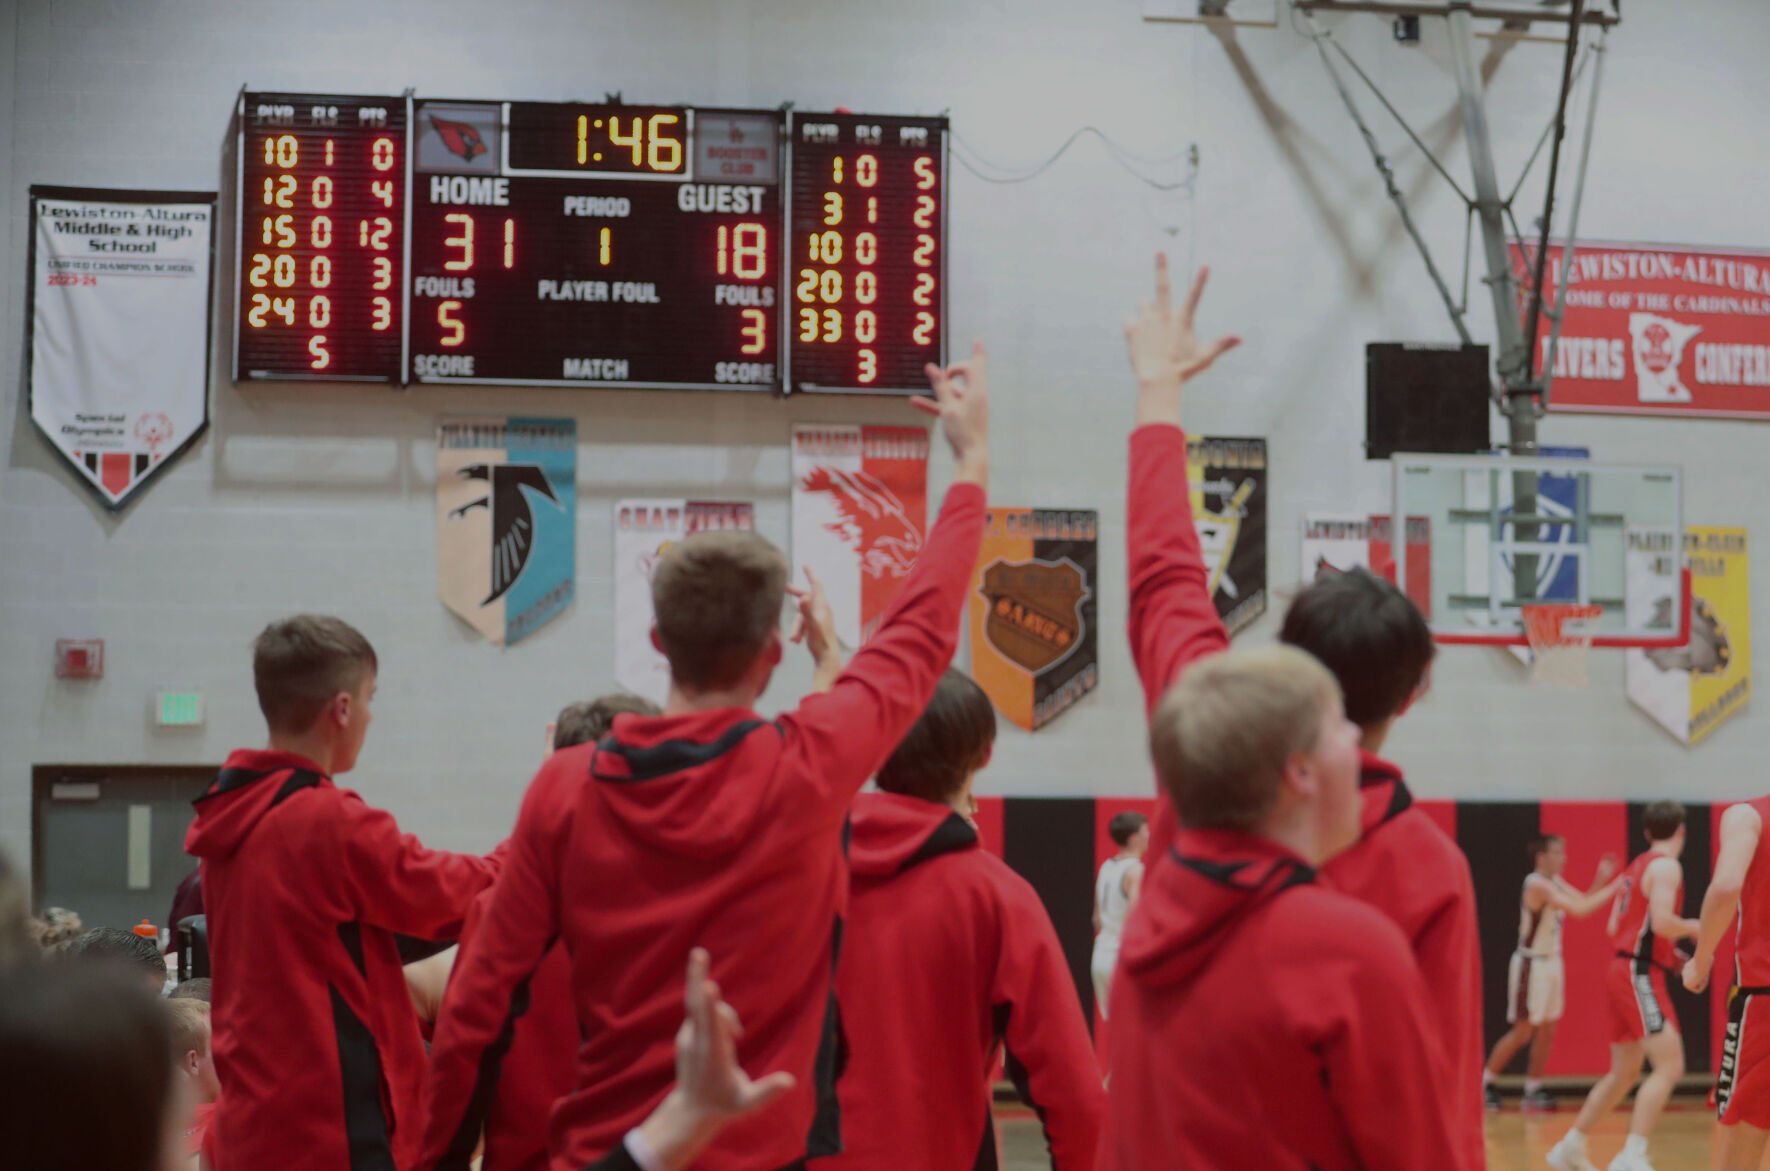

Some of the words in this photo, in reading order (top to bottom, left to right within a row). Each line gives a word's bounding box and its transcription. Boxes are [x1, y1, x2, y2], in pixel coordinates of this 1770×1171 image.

[265, 135, 299, 169] 10
[325, 139, 334, 166] 1
[372, 138, 394, 171] 0
[577, 114, 682, 171] 1:46
[833, 156, 843, 184] 1
[856, 154, 877, 187] 0
[914, 156, 935, 190] 5
[264, 175, 298, 208] 12
[312, 176, 333, 209] 0
[372, 180, 393, 208] 4
[430, 177, 510, 205] HOME
[563, 196, 631, 217] PERIOD
[678, 184, 766, 214] GUEST
[824, 191, 843, 225] 3
[869, 196, 877, 223] 1
[913, 195, 935, 229] 2
[54, 222, 121, 236] Middle
[126, 223, 140, 236] &
[147, 224, 192, 240] High
[88, 240, 157, 253] School
[263, 214, 297, 248] 15
[311, 215, 332, 249] 0
[359, 217, 393, 250] 12
[444, 213, 515, 271] 31
[599, 226, 611, 266] 1
[717, 222, 767, 279] 18
[809, 231, 843, 264] 10
[855, 232, 877, 265] 0
[913, 234, 935, 267] 2
[250, 254, 296, 288] 20
[310, 255, 331, 288] 0
[372, 257, 392, 290] 3
[415, 277, 475, 299] FOULS
[797, 269, 843, 303] 20
[855, 270, 876, 304] 0
[913, 273, 935, 306] 2
[538, 279, 608, 301] PLAYER
[613, 282, 660, 303] FOUL
[715, 285, 775, 307] FOULS
[1608, 292, 1631, 309] OF
[1637, 293, 1671, 311] THE
[248, 294, 295, 328] 24
[309, 295, 331, 328] 0
[372, 296, 391, 330] 3
[437, 301, 465, 346] 5
[800, 308, 842, 343] 33
[855, 310, 876, 344] 0
[913, 312, 934, 345] 2
[741, 308, 766, 354] 3
[308, 335, 330, 369] 5
[414, 354, 475, 377] SCORE
[563, 358, 629, 380] MATCH
[858, 349, 876, 383] 3
[714, 362, 775, 384] SCORE
